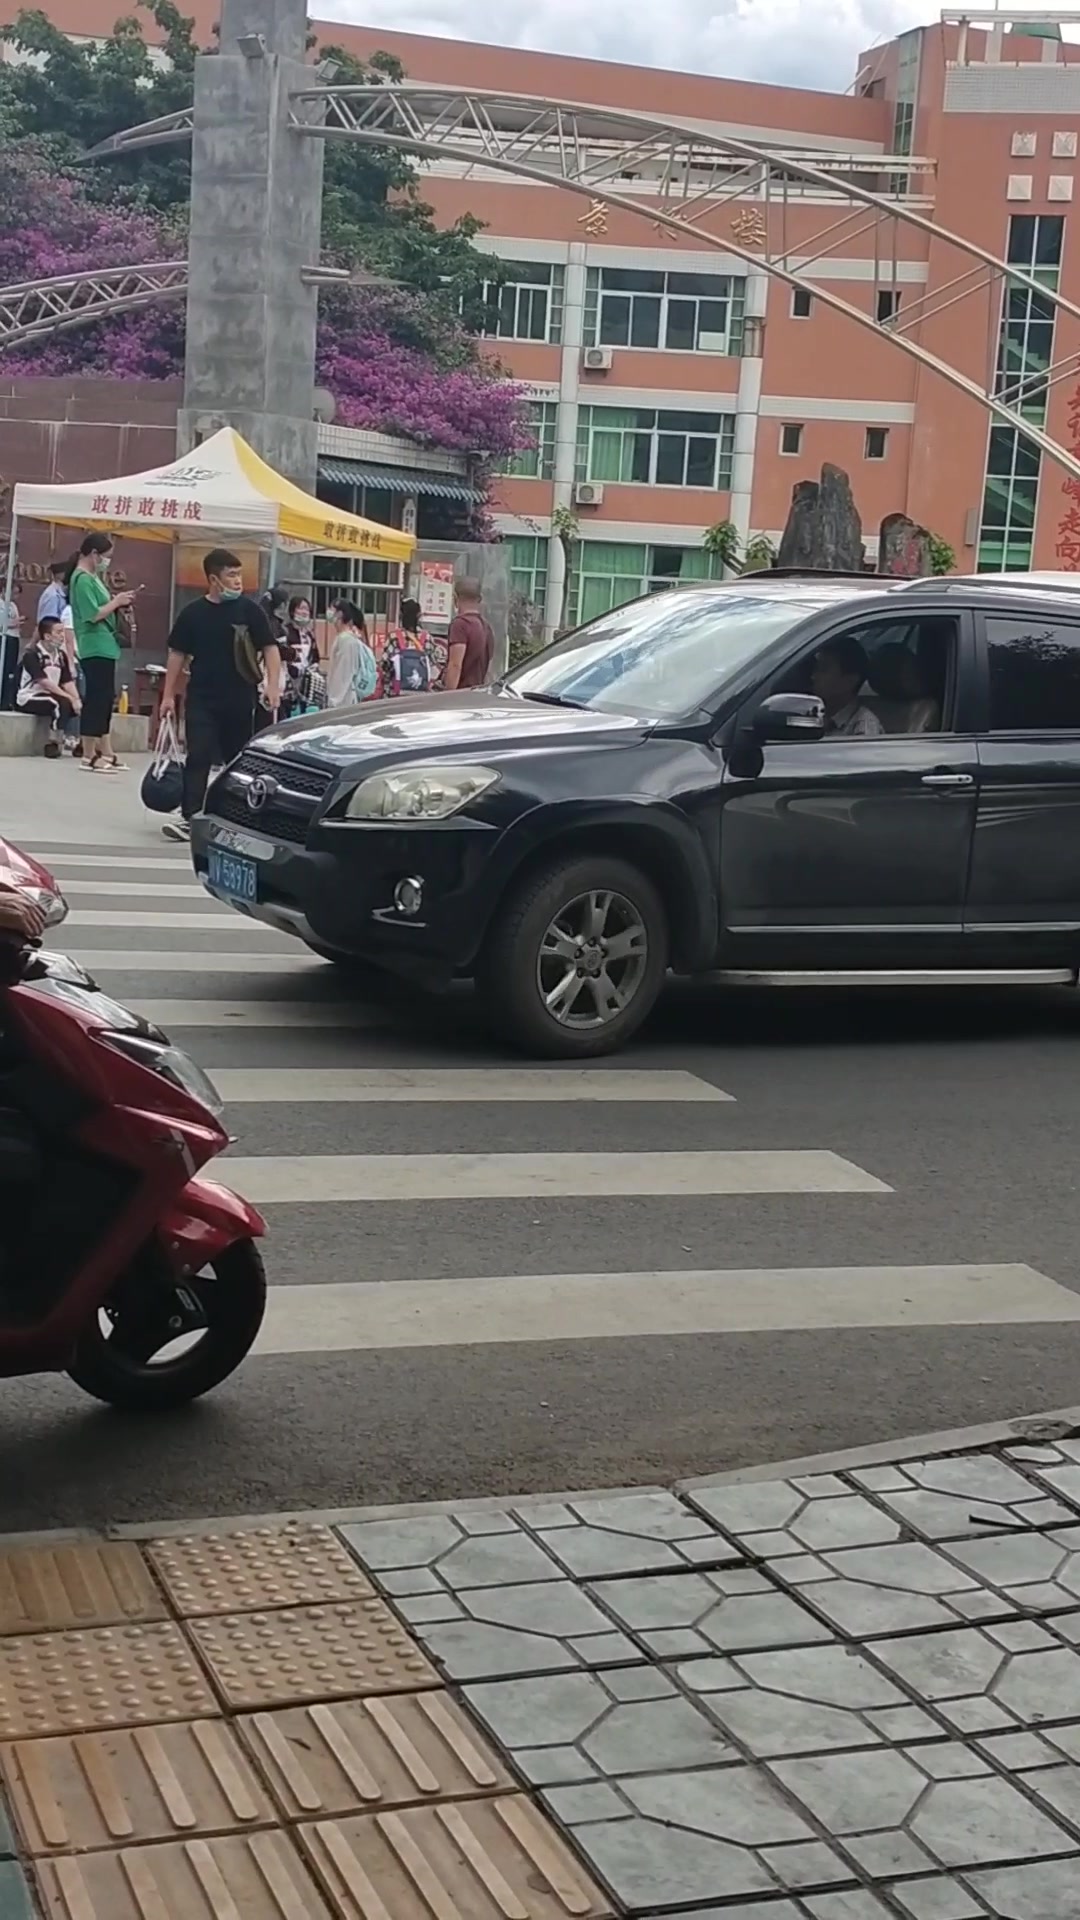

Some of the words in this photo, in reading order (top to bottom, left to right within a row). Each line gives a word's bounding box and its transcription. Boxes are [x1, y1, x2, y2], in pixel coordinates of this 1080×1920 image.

[91, 494, 202, 521] 敢拼敢挑战
